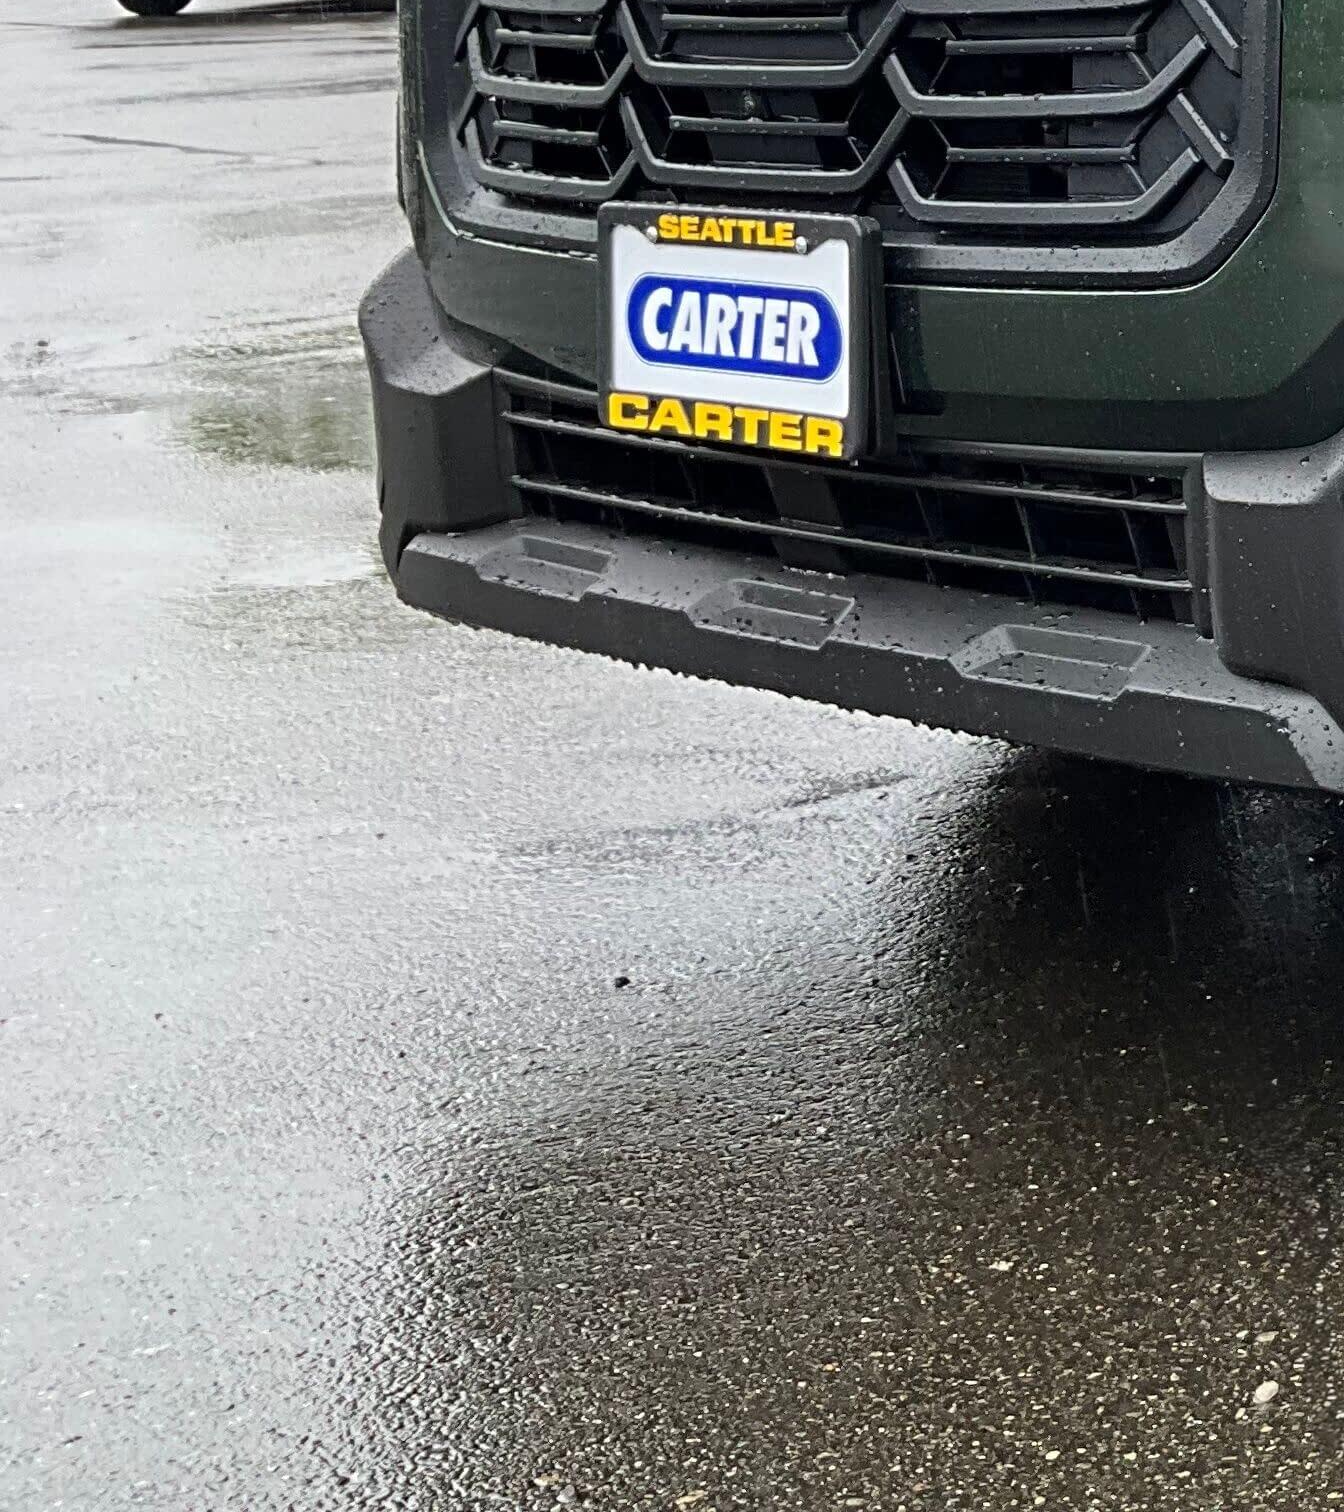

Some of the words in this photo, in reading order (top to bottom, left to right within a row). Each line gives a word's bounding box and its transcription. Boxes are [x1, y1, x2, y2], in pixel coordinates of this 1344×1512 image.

[658, 213, 796, 248] SEATTLE
[642, 287, 821, 367] CARTER
[608, 392, 844, 457] CARTER
